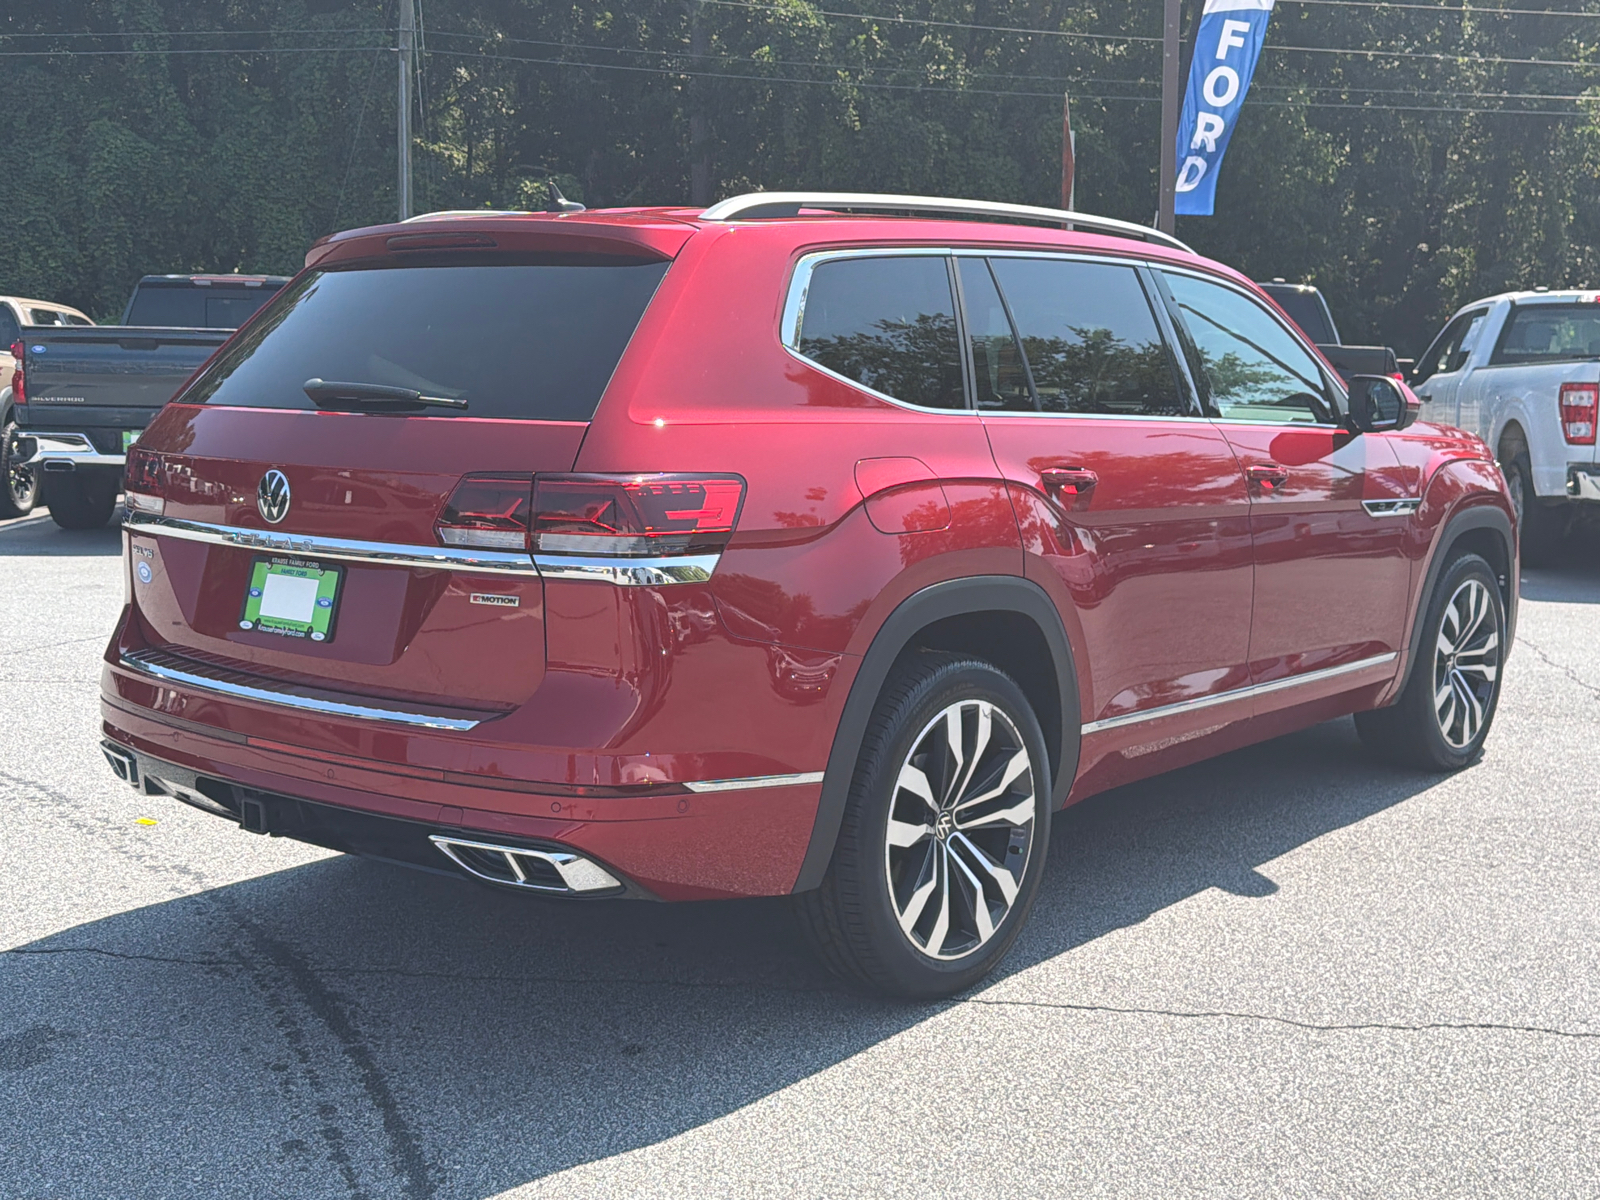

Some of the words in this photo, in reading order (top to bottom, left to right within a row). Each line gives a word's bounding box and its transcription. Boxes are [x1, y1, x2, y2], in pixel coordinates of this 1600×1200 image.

[1175, 19, 1250, 192] FORD
[233, 531, 314, 550] ATLAS
[272, 557, 288, 565] KRAUSE
[289, 559, 305, 567] FAMILY
